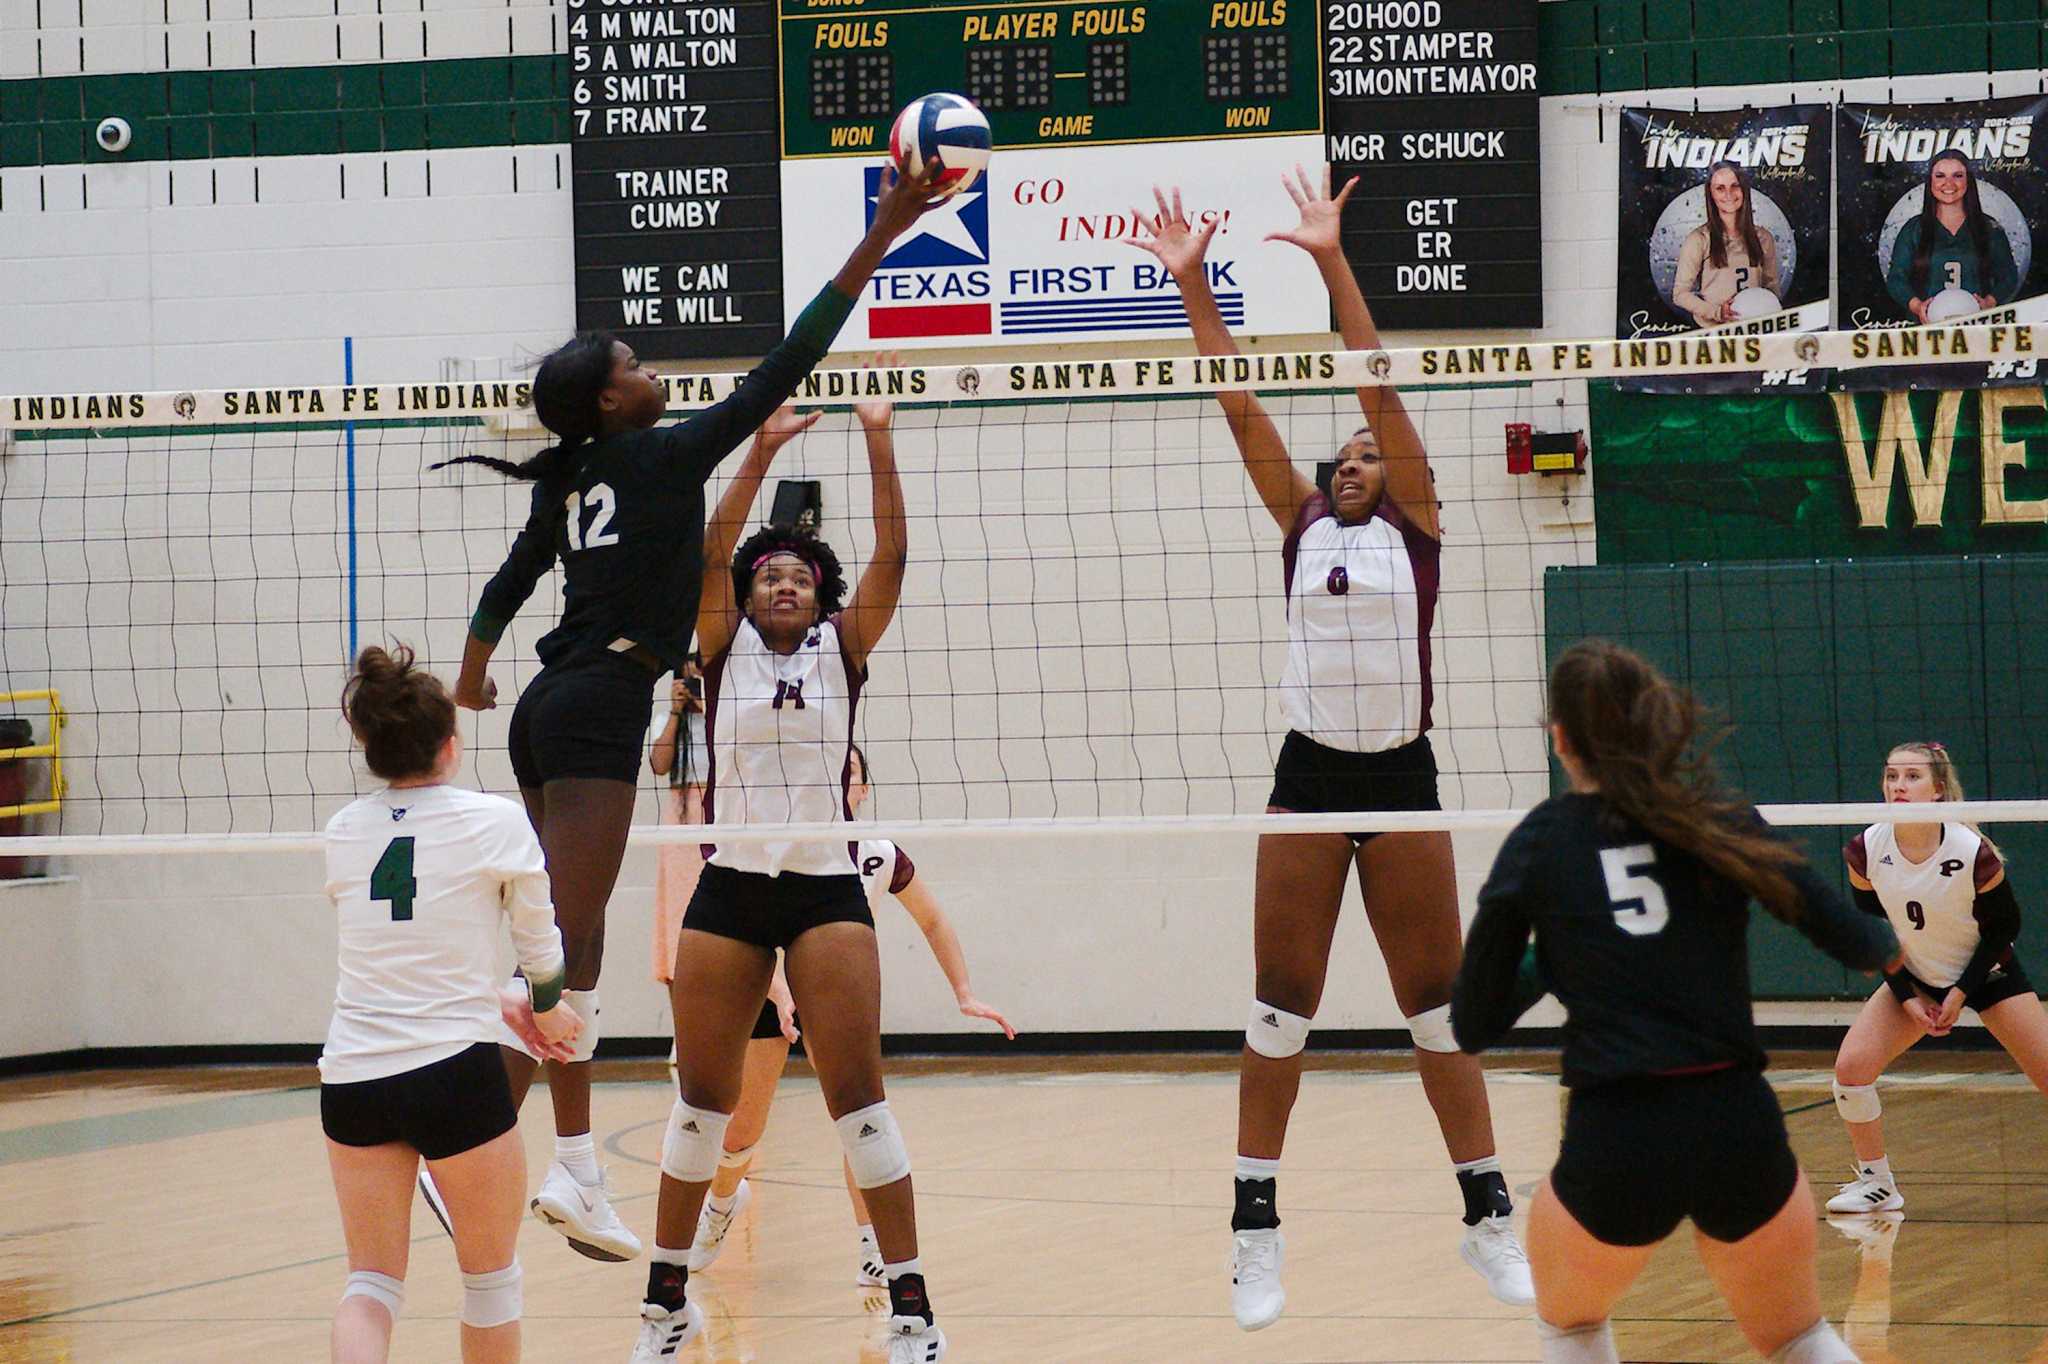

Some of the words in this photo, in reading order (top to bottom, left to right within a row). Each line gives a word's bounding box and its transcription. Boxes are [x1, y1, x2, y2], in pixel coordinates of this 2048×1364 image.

[570, 15, 588, 41] 4
[601, 13, 621, 39] M
[630, 8, 736, 37] WALTON
[963, 12, 1057, 41] PLAYER
[1071, 8, 1146, 36] FOULS
[1210, 0, 1286, 29] FOULS
[814, 21, 888, 49] FOULS
[1328, 37, 1363, 63] 22
[1370, 32, 1493, 61] STAMPER
[574, 45, 591, 71] 5
[602, 45, 617, 71] A
[630, 39, 736, 68] WALTON
[574, 79, 591, 104] 6
[605, 75, 685, 102] SMITH
[574, 109, 591, 135] 7
[606, 106, 707, 134] FRANTZ
[1039, 115, 1094, 138] GAME
[1226, 107, 1270, 128] WON
[1641, 115, 1684, 145] Lady
[1859, 108, 1903, 139] Lady
[831, 127, 874, 147] WON
[1331, 134, 1384, 161] MGR
[1402, 131, 1505, 160] SCHUCK
[1646, 133, 1808, 168] INDIANS
[1865, 124, 2032, 163] INDIANS
[616, 168, 728, 198] TRAINER
[1014, 178, 1064, 205] GO
[630, 200, 721, 229] CUMBY
[1406, 199, 1458, 226] GET
[1417, 232, 1451, 258] ER
[622, 266, 660, 293] WE
[678, 264, 728, 290] CAN
[871, 271, 990, 300] TEXAS
[1010, 266, 1115, 295] FIRST
[1134, 261, 1237, 289] BAK
[1397, 265, 1467, 292] DONE
[1735, 268, 1748, 292] 2
[1944, 262, 1961, 289] 3
[622, 298, 662, 326] WE
[676, 296, 742, 324] WILL
[1423, 346, 1532, 375] SANTA
[1554, 343, 1592, 370] FE
[1614, 338, 1761, 367] INDIANS
[1853, 329, 1968, 358] SANTA
[1990, 326, 2032, 352] FE
[1011, 363, 1115, 390] SANTA
[1136, 360, 1173, 386] FE
[1194, 354, 1335, 383] INDIANS
[14, 394, 144, 420] INDIANS
[224, 389, 324, 416] SANTA
[343, 387, 378, 412] FE
[398, 383, 531, 410] INDIANS
[565, 482, 619, 551] 12
[370, 836, 416, 921] 4
[862, 856, 884, 876] P
[1940, 859, 1964, 877] P
[1600, 843, 1669, 936] 5
[1906, 901, 1925, 930] 9
